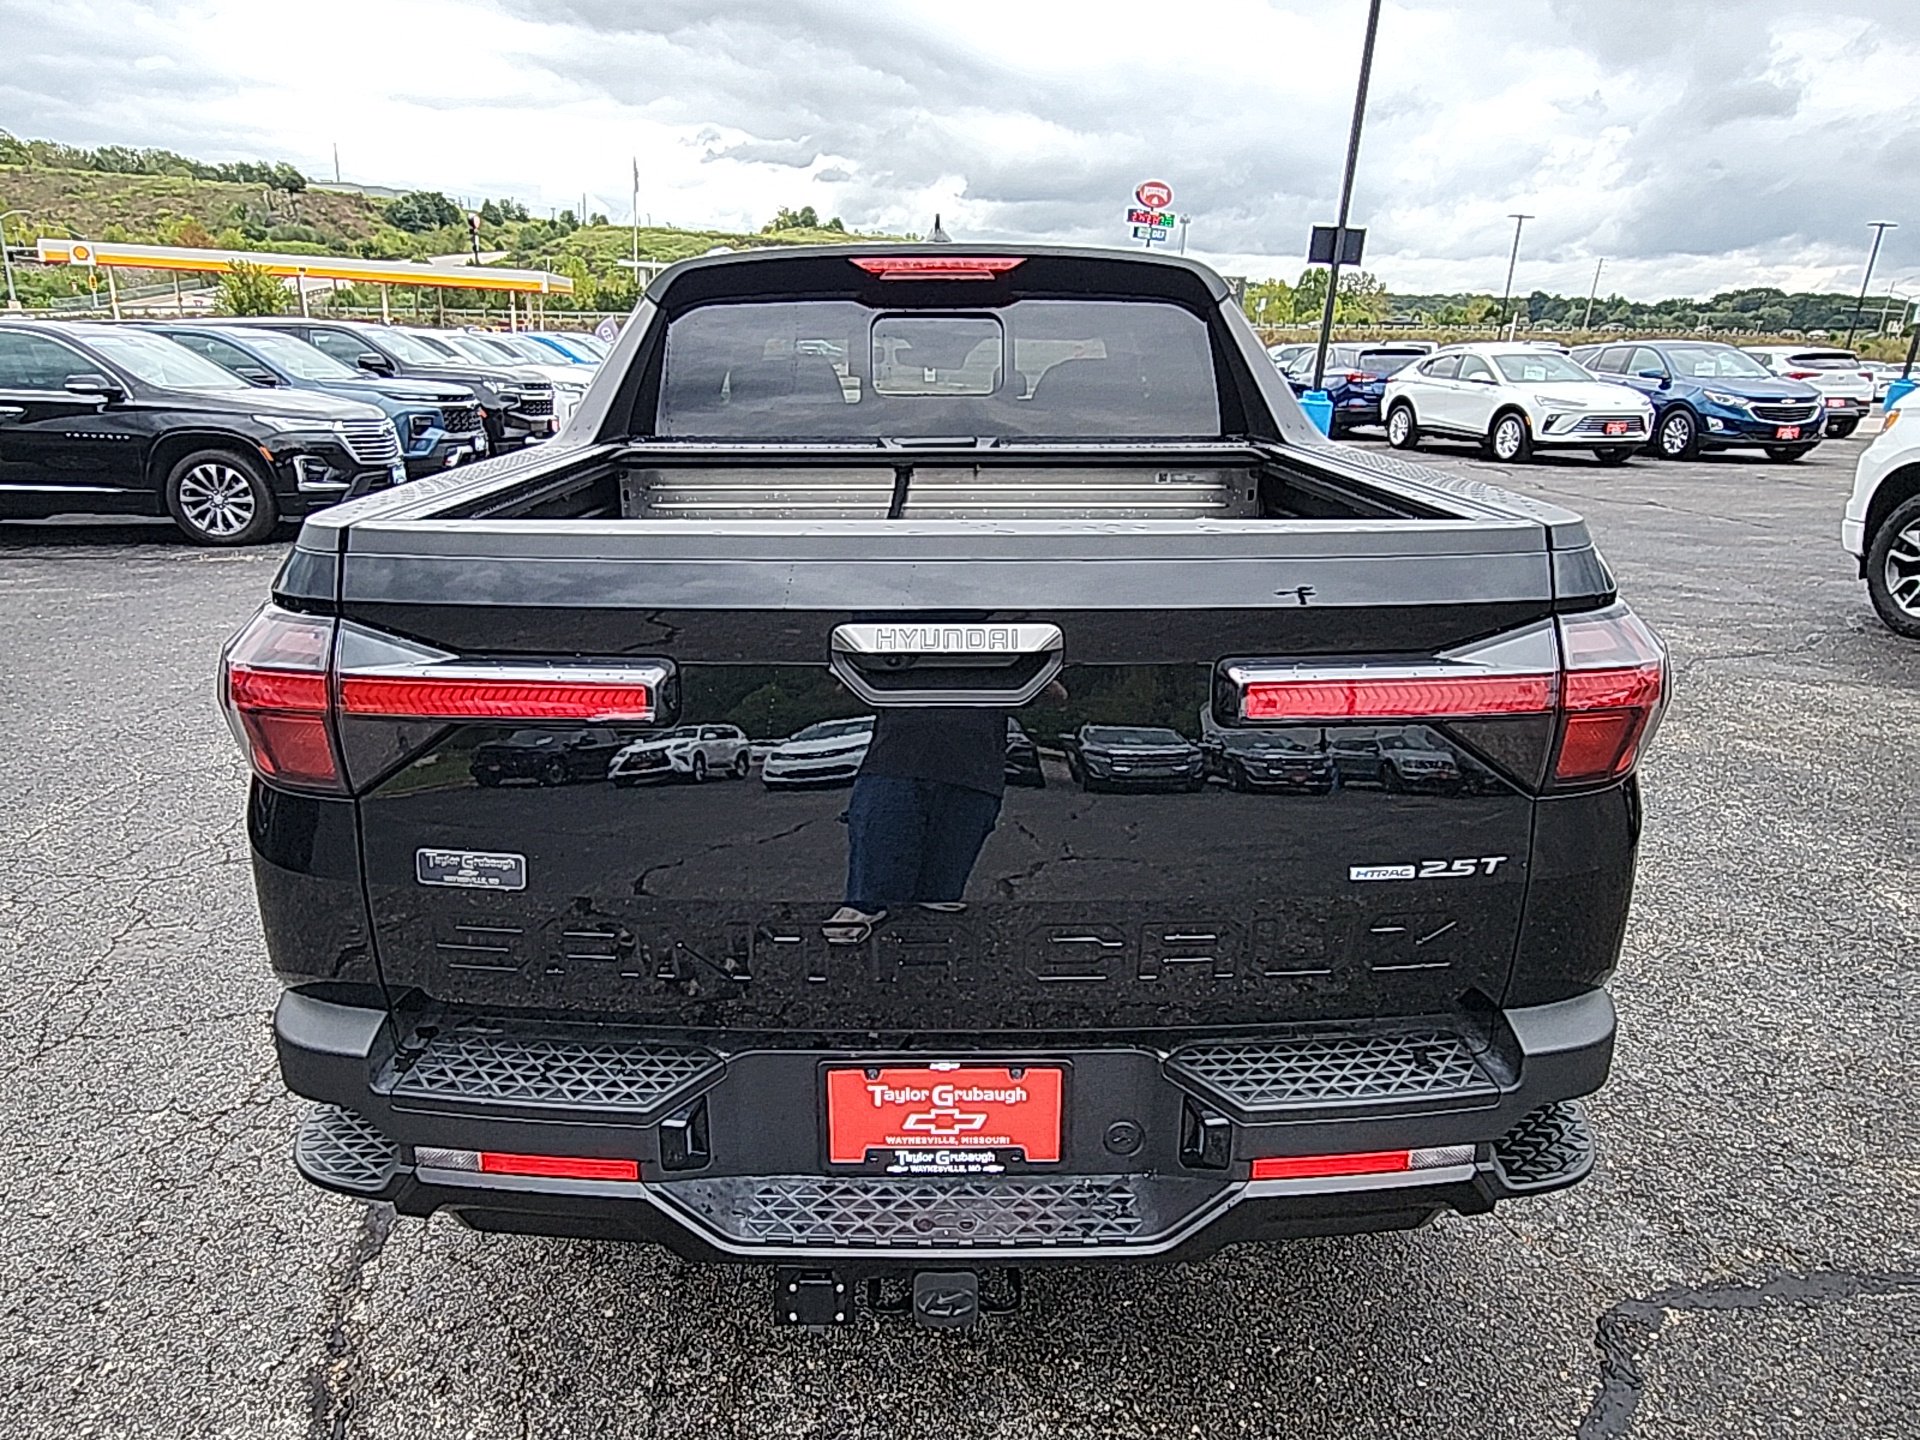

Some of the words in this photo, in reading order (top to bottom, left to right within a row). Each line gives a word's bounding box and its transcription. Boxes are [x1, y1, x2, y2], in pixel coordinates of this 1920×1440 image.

[876, 628, 1018, 649] HYUNDAI
[1355, 868, 1412, 878] HTRAC
[867, 1085, 929, 1107] Taylor
[932, 1085, 1027, 1107] Grubaugh
[886, 1136, 959, 1146] WAYNESVILLE,
[961, 1136, 1010, 1145] MISSOURI
[895, 1150, 934, 1165] Taylor
[936, 1150, 996, 1164] Grubaugh
